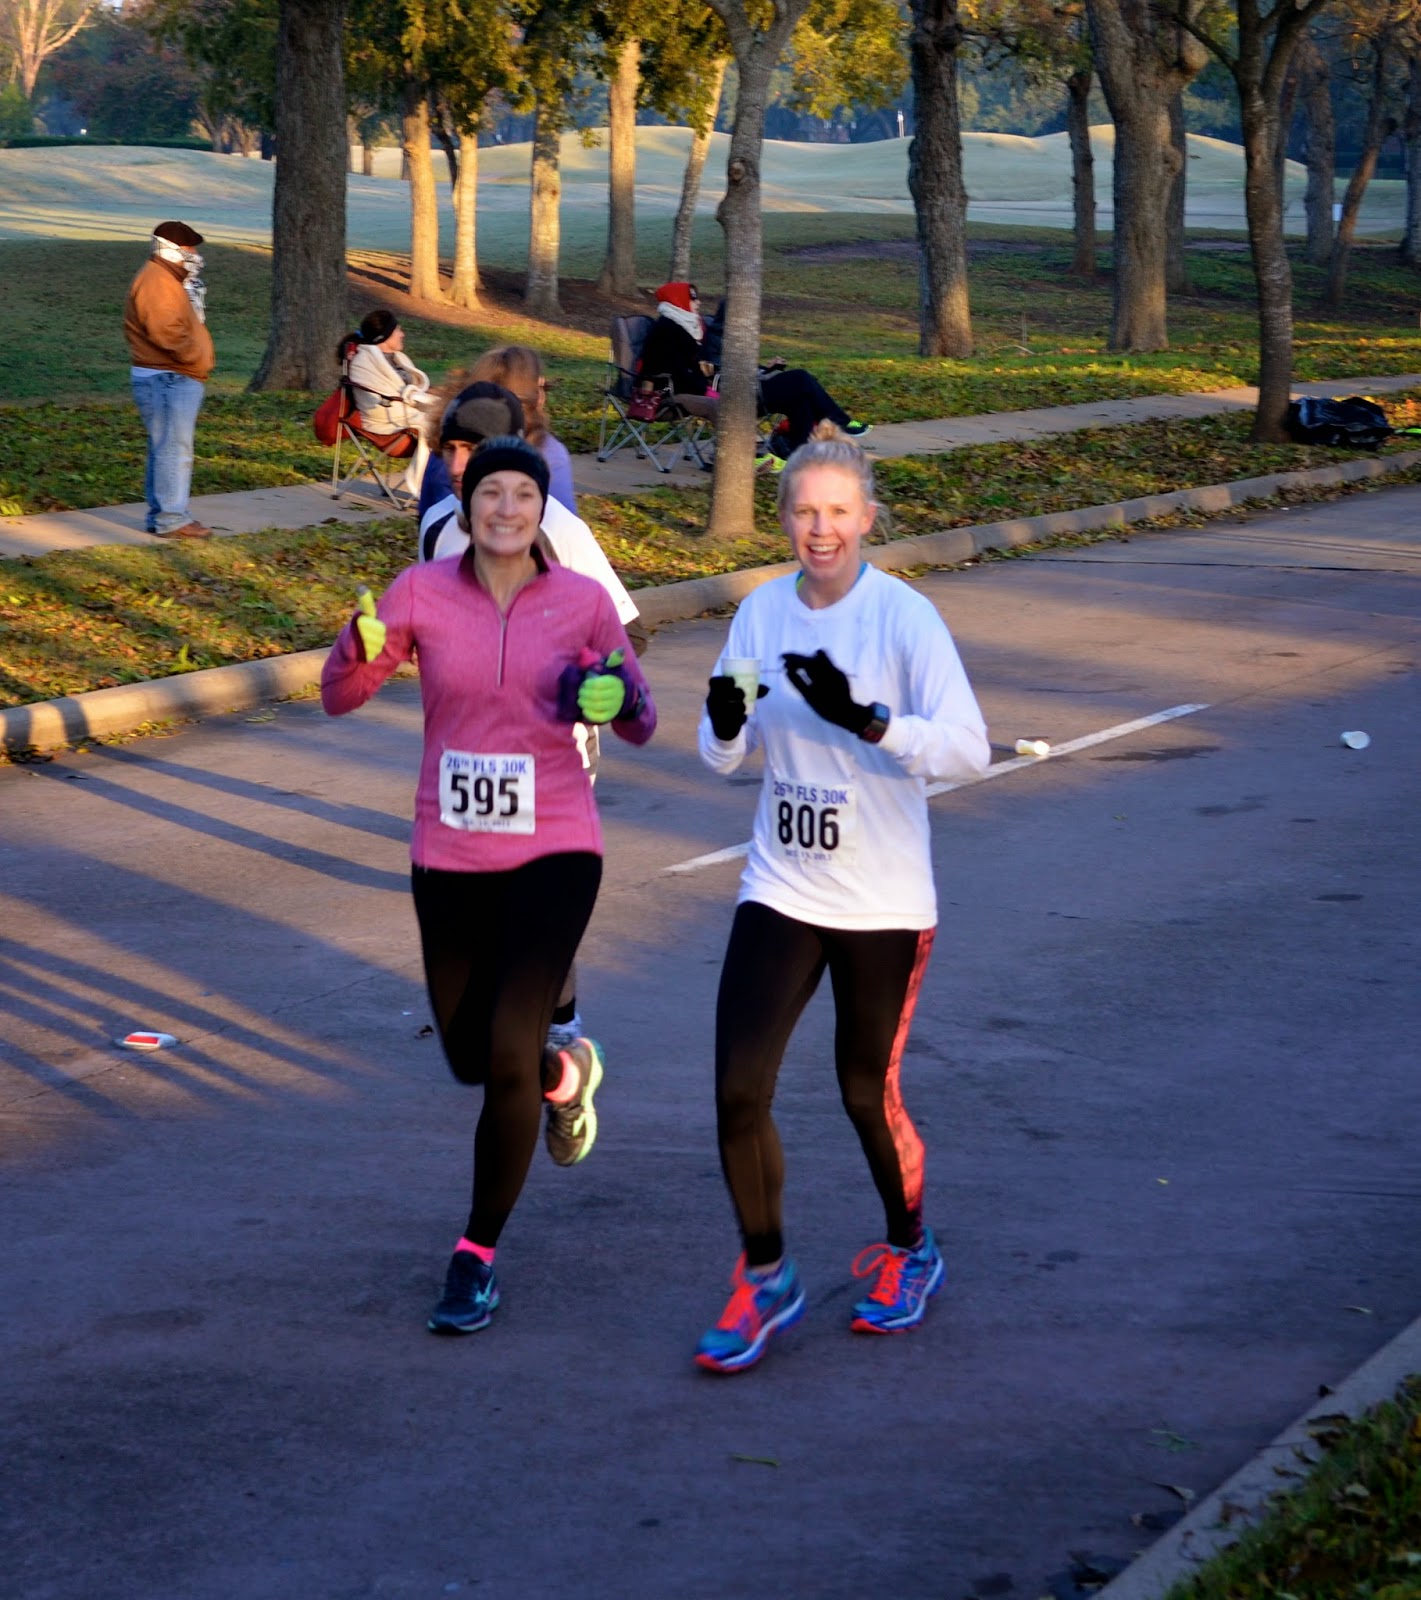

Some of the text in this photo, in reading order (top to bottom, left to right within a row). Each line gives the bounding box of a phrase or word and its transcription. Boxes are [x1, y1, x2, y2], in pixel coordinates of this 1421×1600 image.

[451, 773, 519, 816] 595
[796, 785, 817, 802] FLS
[821, 789, 848, 804] 30K
[778, 800, 839, 850] 806
